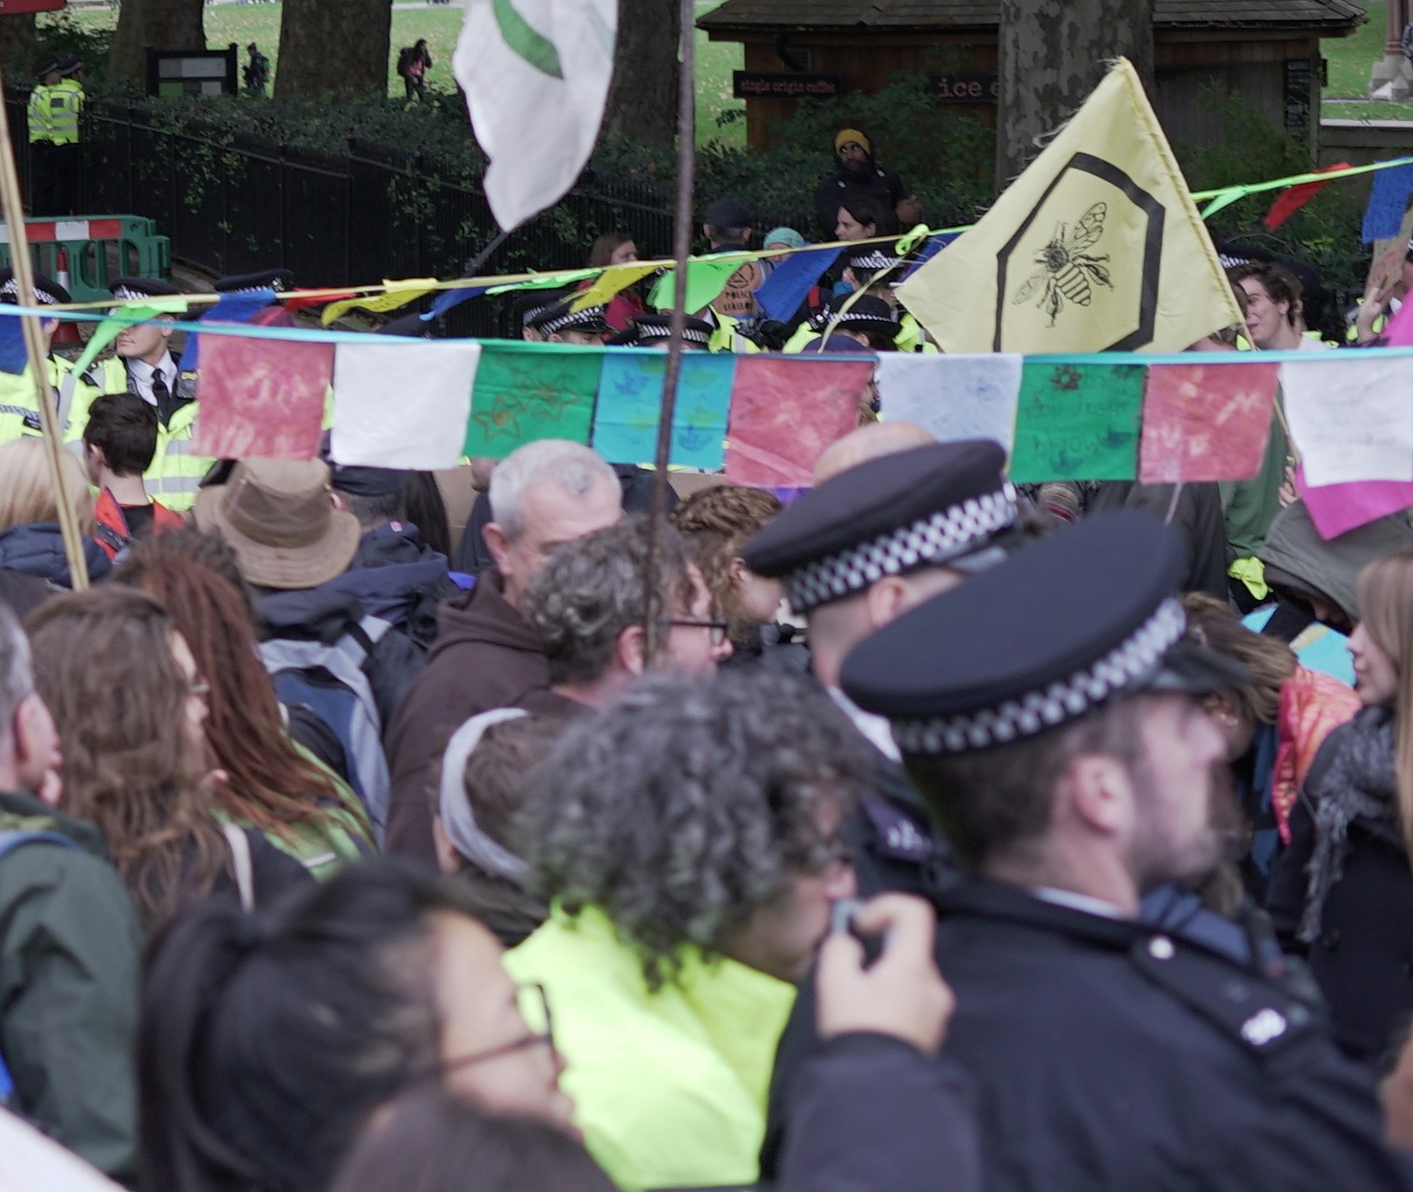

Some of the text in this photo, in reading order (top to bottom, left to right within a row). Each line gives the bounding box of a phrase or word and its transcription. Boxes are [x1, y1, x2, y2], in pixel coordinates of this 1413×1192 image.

[740, 79, 770, 94] single
[772, 80, 804, 95] origin
[938, 78, 982, 98] ice
